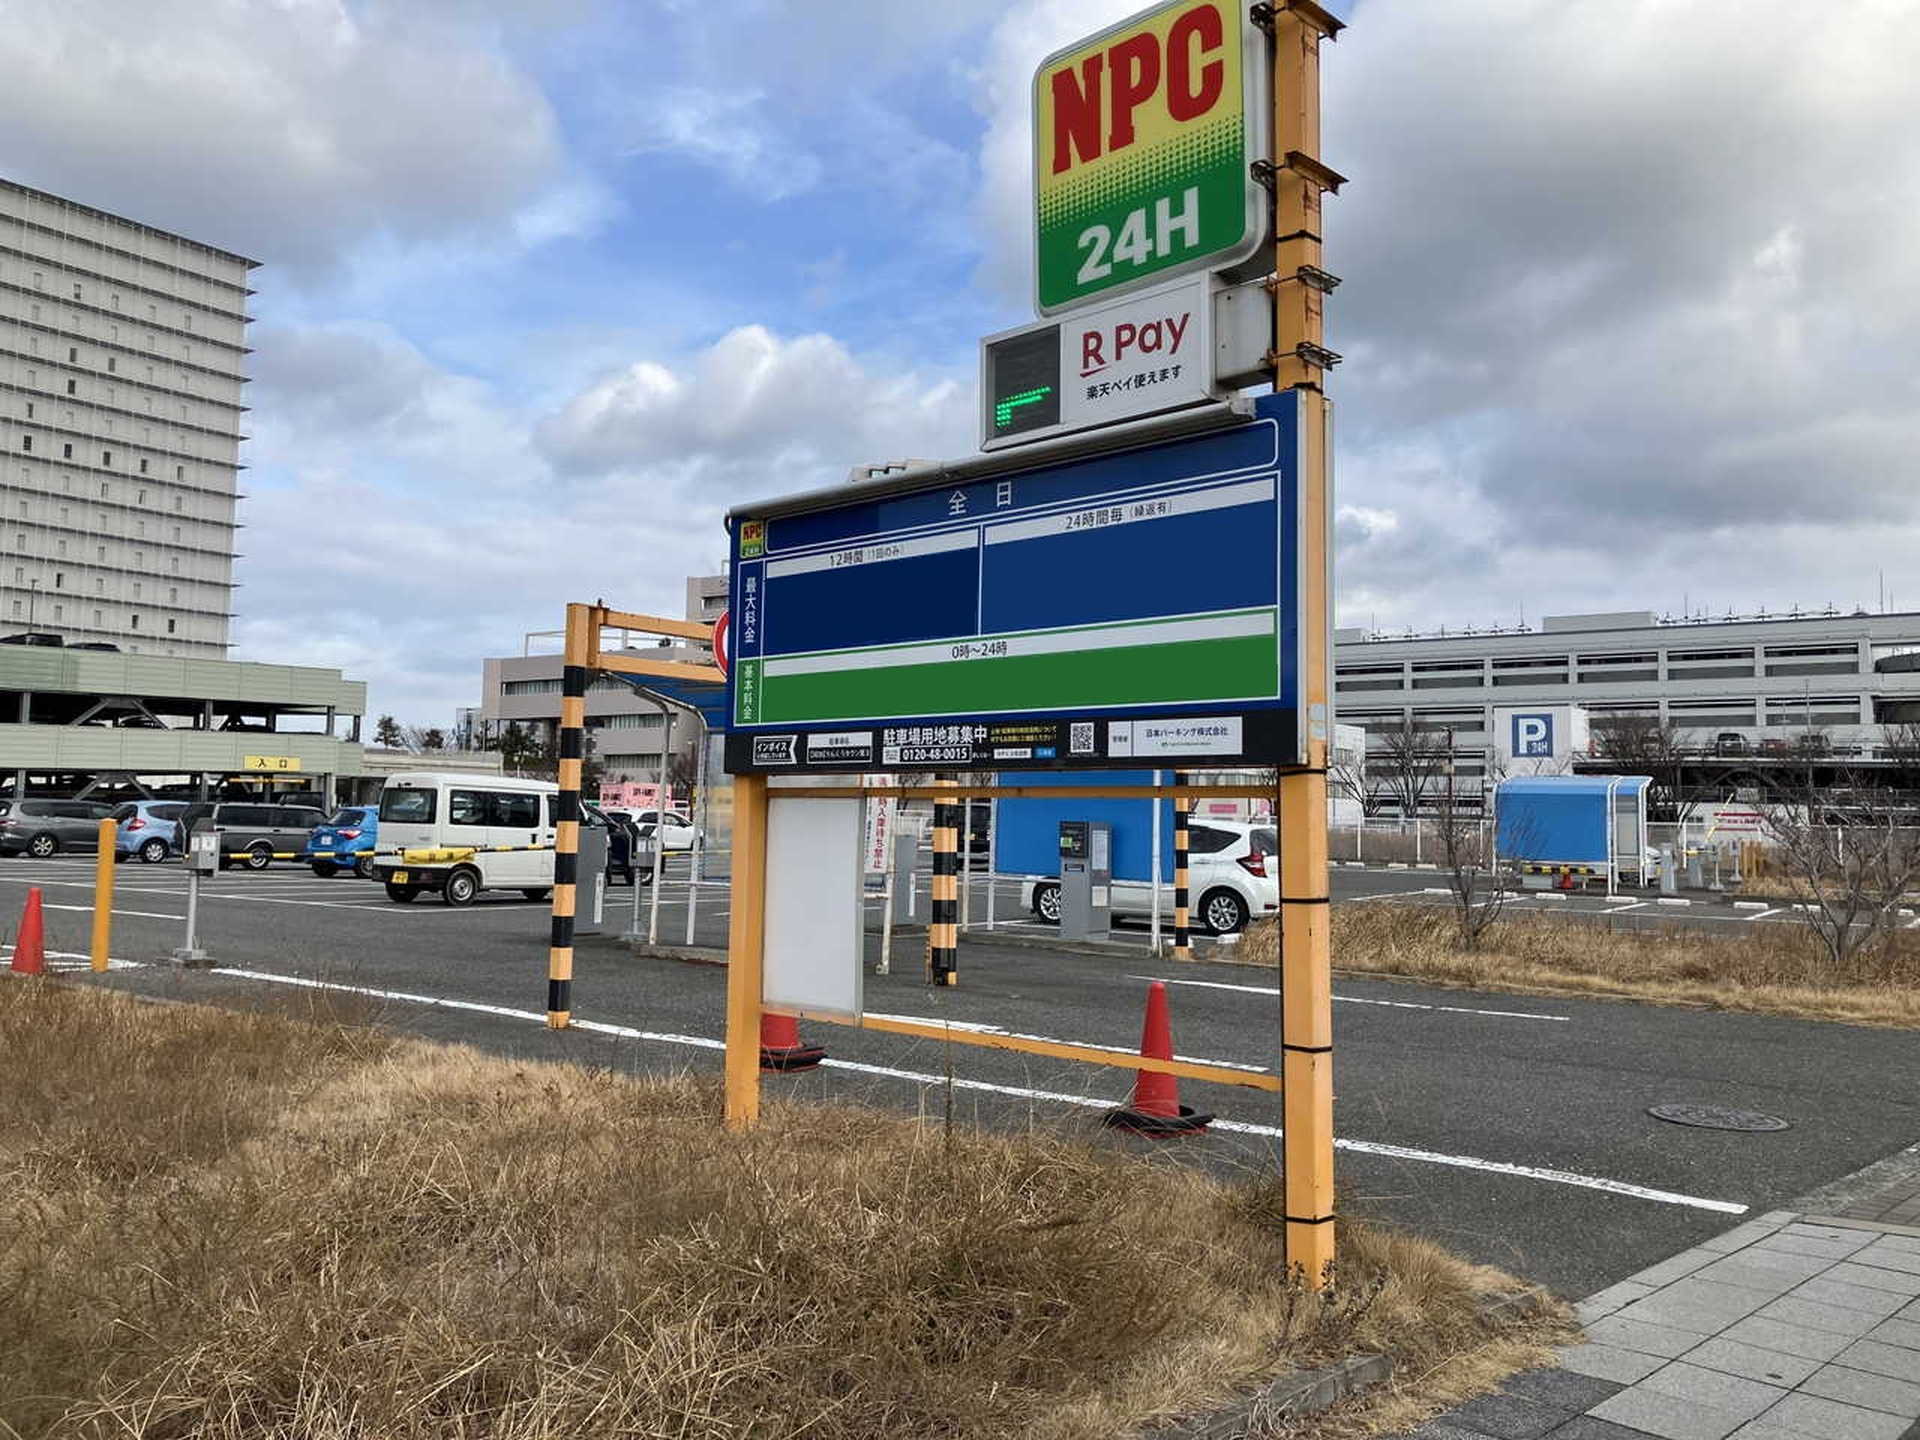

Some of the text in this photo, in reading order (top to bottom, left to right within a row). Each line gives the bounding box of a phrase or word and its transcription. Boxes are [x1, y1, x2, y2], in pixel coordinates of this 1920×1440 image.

[1052, 4, 1224, 175] NPC
[1077, 186, 1200, 285] 24H
[1081, 312, 1191, 377] R Pay
[1086, 365, 1182, 400] 楽天ペイ使えます
[743, 524, 762, 540] NPC
[744, 576, 757, 643] 最大料金
[743, 665, 753, 720] 基本料金
[756, 742, 787, 752] インボイス
[883, 725, 988, 746] 駐車場用地募集中
[1145, 726, 1228, 738] 日本パーキング株式会社
[1519, 718, 1546, 754] P
[256, 758, 287, 768] 入口
[902, 747, 968, 761] 0120-48-0015
